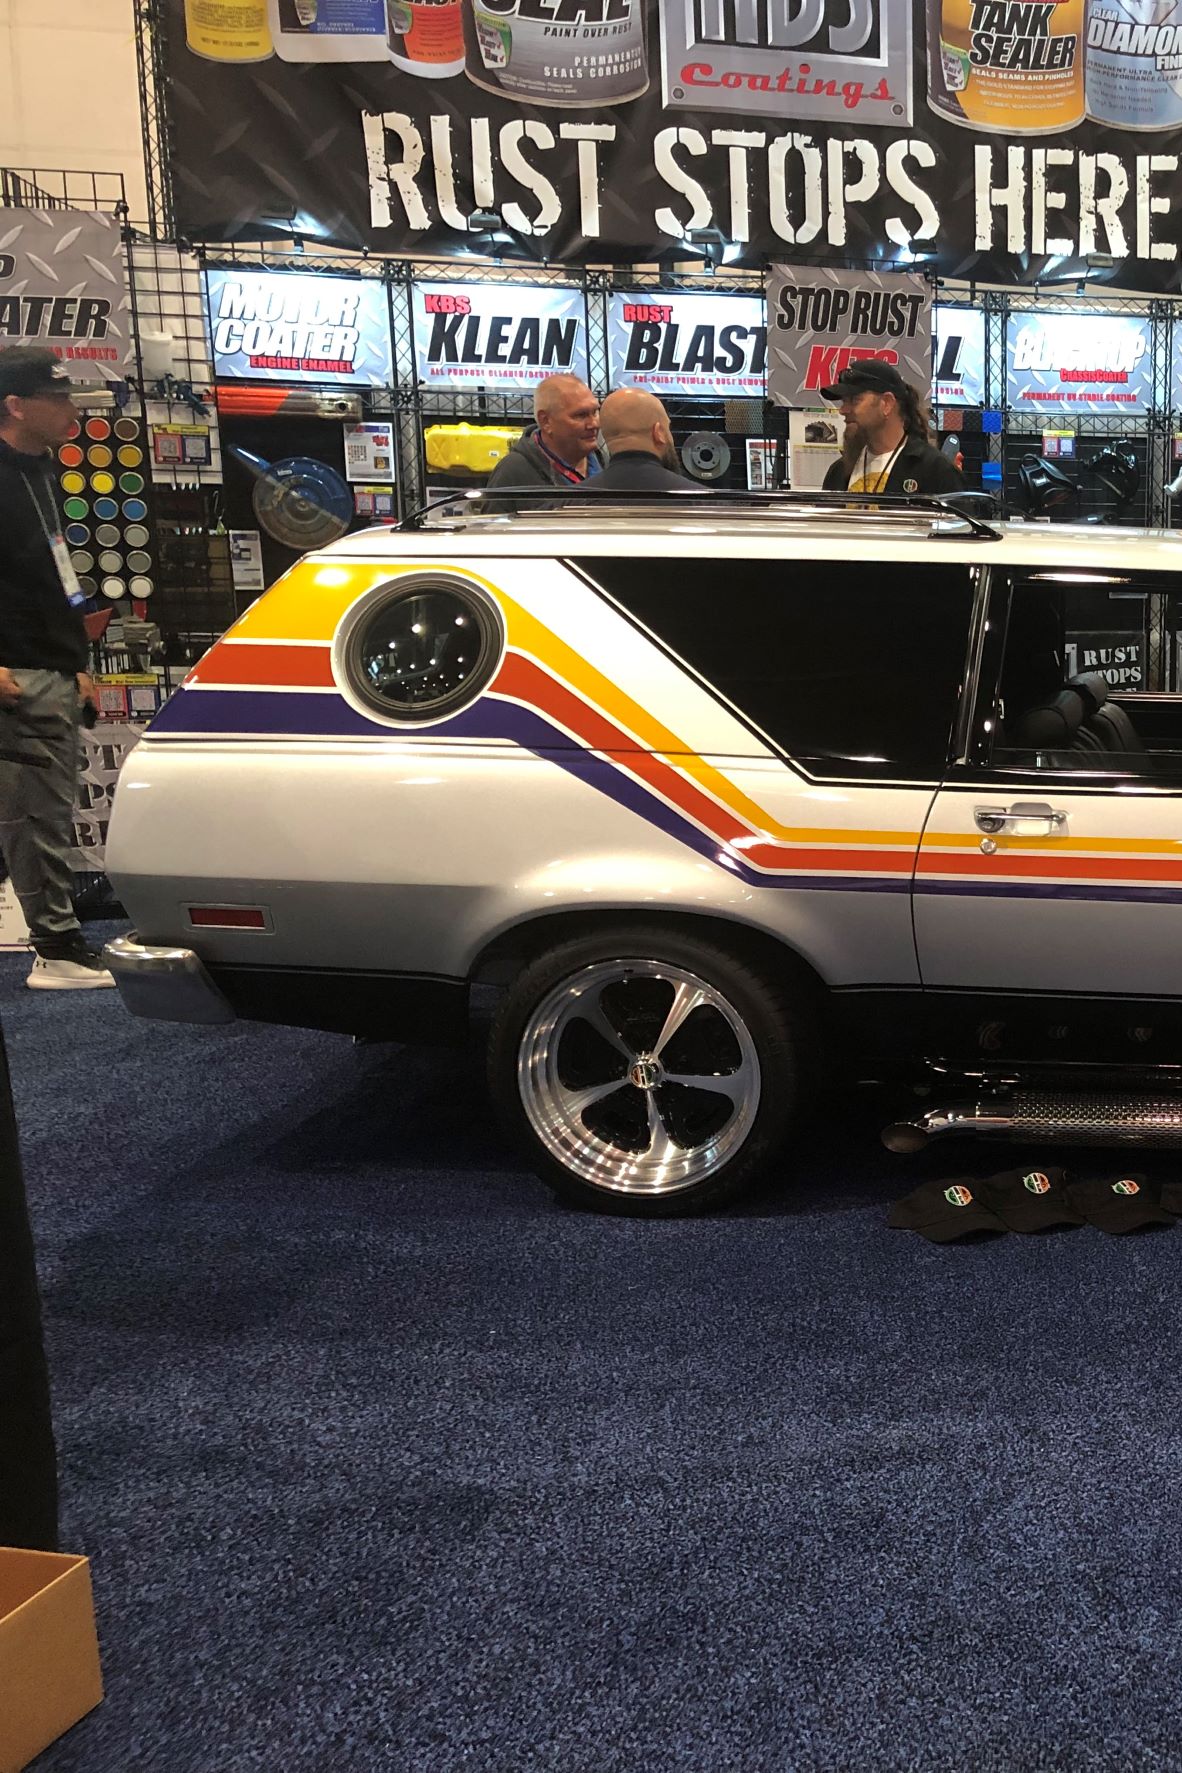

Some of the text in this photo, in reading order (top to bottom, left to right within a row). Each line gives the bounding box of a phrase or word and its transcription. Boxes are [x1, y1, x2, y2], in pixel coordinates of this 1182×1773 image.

[544, 22, 632, 38] PAINT OVER RUST
[968, 2, 1056, 37] TANK
[1092, 8, 1119, 20] CLEAR
[544, 58, 642, 78] SEALS CORROSION
[968, 32, 1077, 71] SEALER
[1088, 61, 1152, 76] PERMANENT ULTRA
[681, 62, 895, 108] Coatings
[972, 68, 996, 78] SEALS
[1044, 72, 1074, 80] PINHOLES
[361, 109, 616, 237] RUST
[654, 126, 940, 247] STOPS
[0, 295, 112, 340] ATER
[424, 294, 471, 314] KBS
[624, 304, 672, 322] RUST
[776, 284, 926, 338] STOP RUST
[214, 318, 360, 362] COATER
[426, 313, 579, 367] KLEAN
[624, 322, 767, 375] BLAST
[1012, 333, 1146, 372] BLOP
[250, 356, 354, 374] ENGINE ENAMEL
[804, 344, 898, 390] KI
[1084, 646, 1140, 666] RUST
[1093, 667, 1142, 685] TOPS
